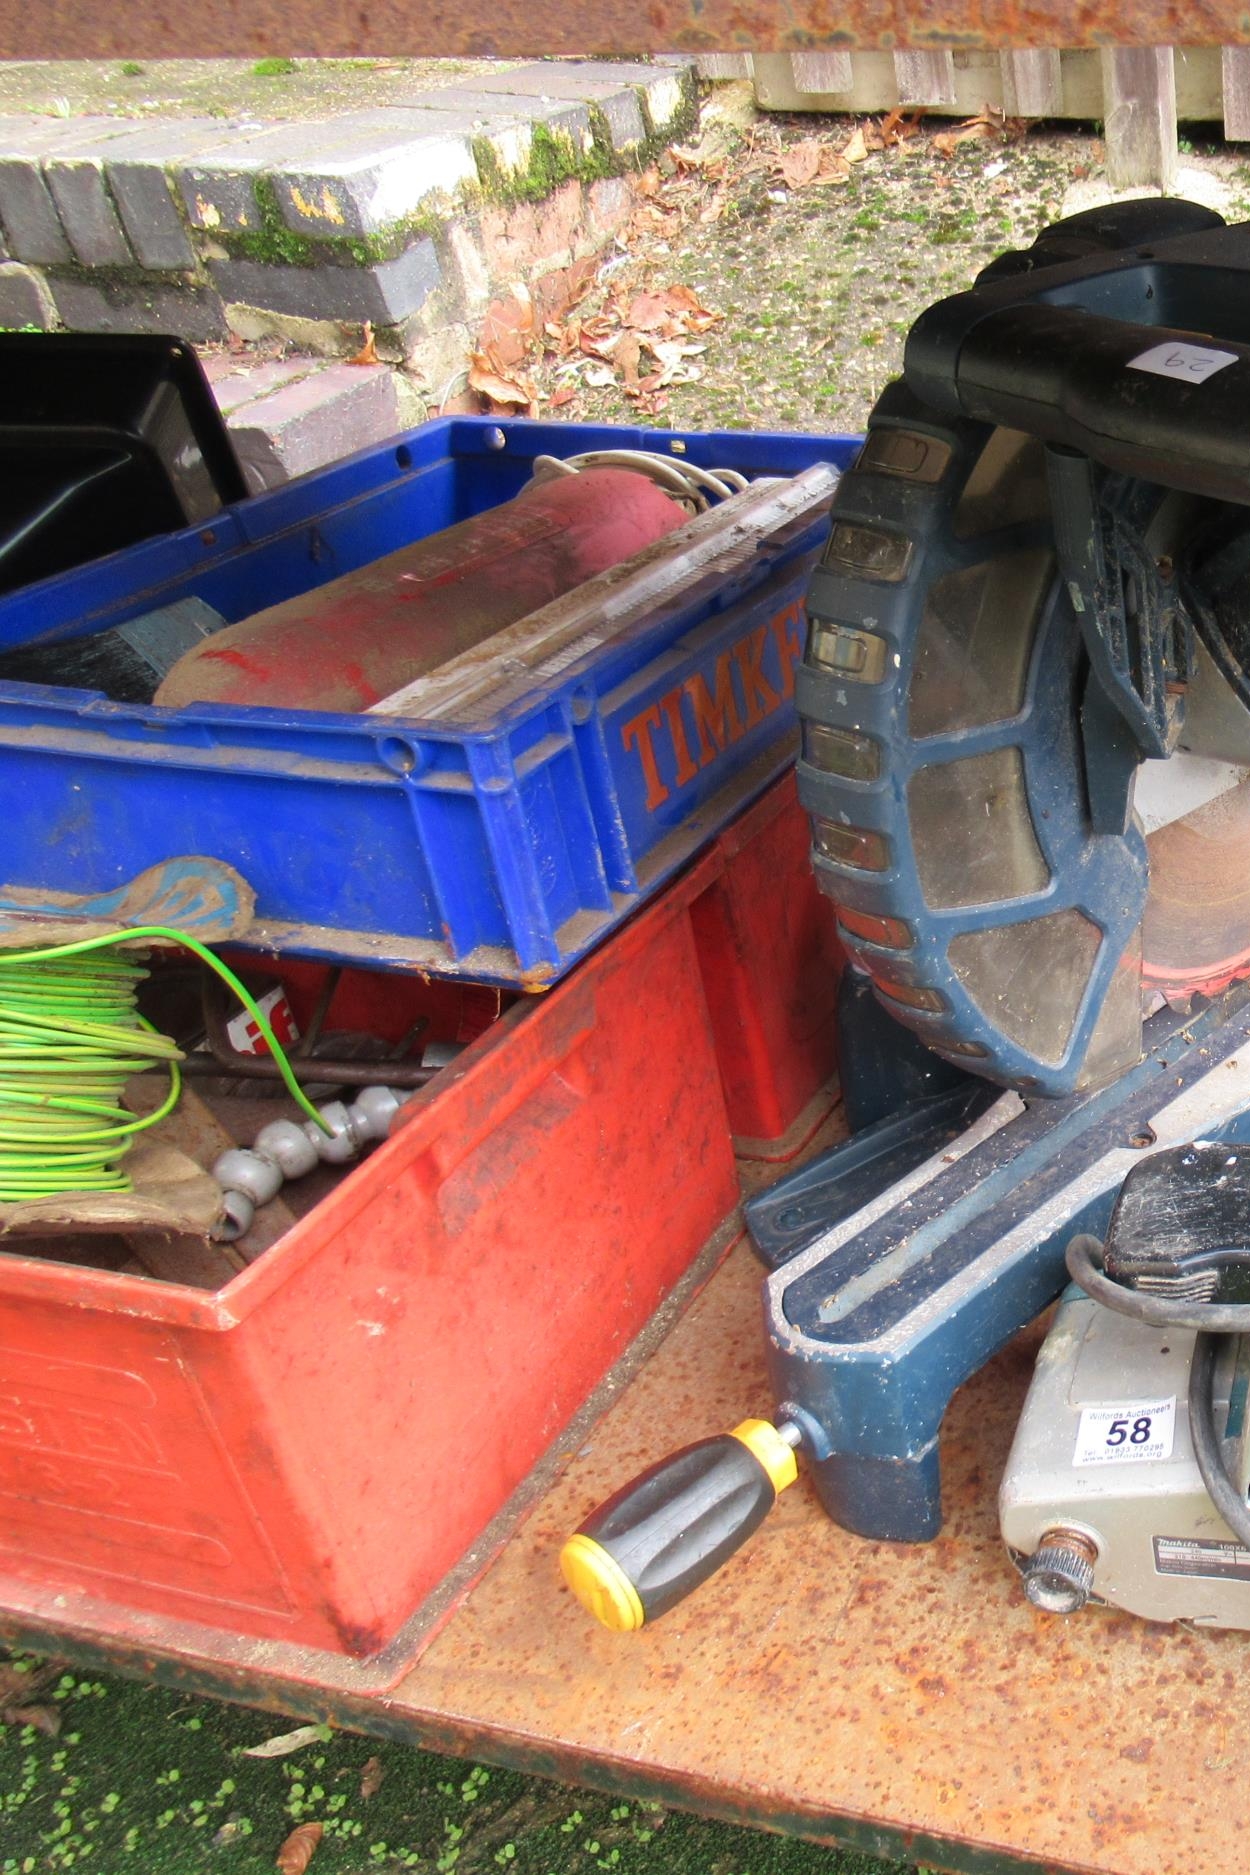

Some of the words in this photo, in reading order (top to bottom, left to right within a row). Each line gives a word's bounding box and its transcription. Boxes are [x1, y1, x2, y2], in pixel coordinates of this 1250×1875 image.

[621, 596, 808, 813] TIMKE
[1089, 1410, 1123, 1420] Wilfords
[1126, 1404, 1171, 1418] Auctioneers
[1105, 1416, 1152, 1446] 58
